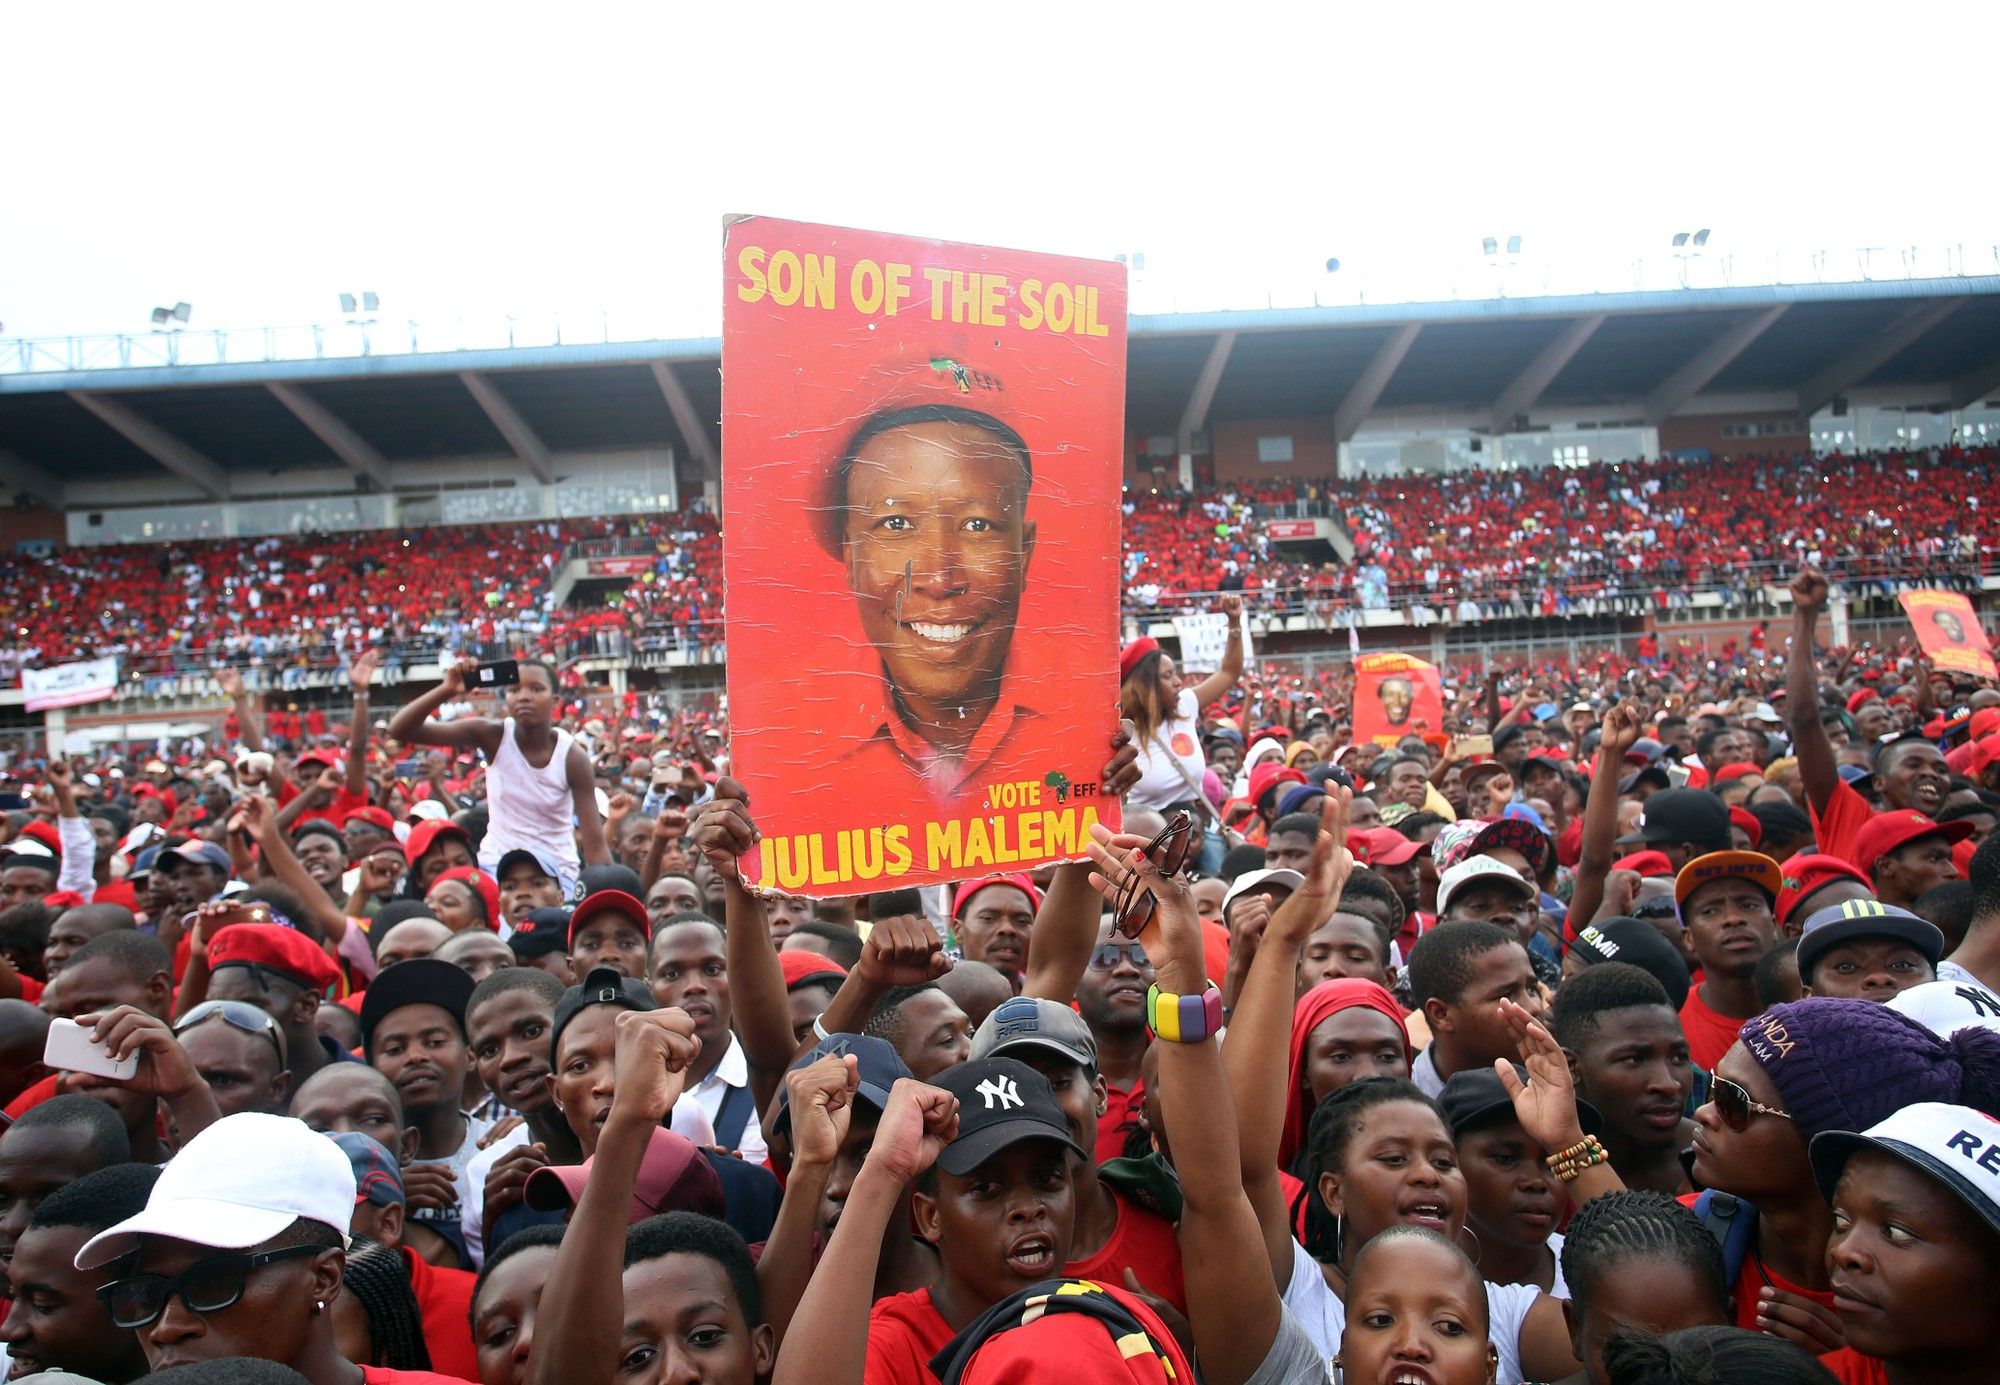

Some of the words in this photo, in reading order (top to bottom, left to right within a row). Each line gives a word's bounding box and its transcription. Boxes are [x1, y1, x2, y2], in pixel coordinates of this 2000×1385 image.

[737, 245, 836, 310] SON
[850, 259, 911, 316] OF
[923, 267, 1007, 326] THE
[1018, 279, 1109, 337] SOIL
[988, 781, 1041, 809] VOTE
[1073, 782, 1097, 797] EFF
[757, 824, 913, 889] JULIUS
[925, 806, 1105, 871] MALEMA
[997, 1021, 1039, 1039] RAW
[1758, 1014, 1795, 1058] ANDA
[975, 1074, 1025, 1110] NY
